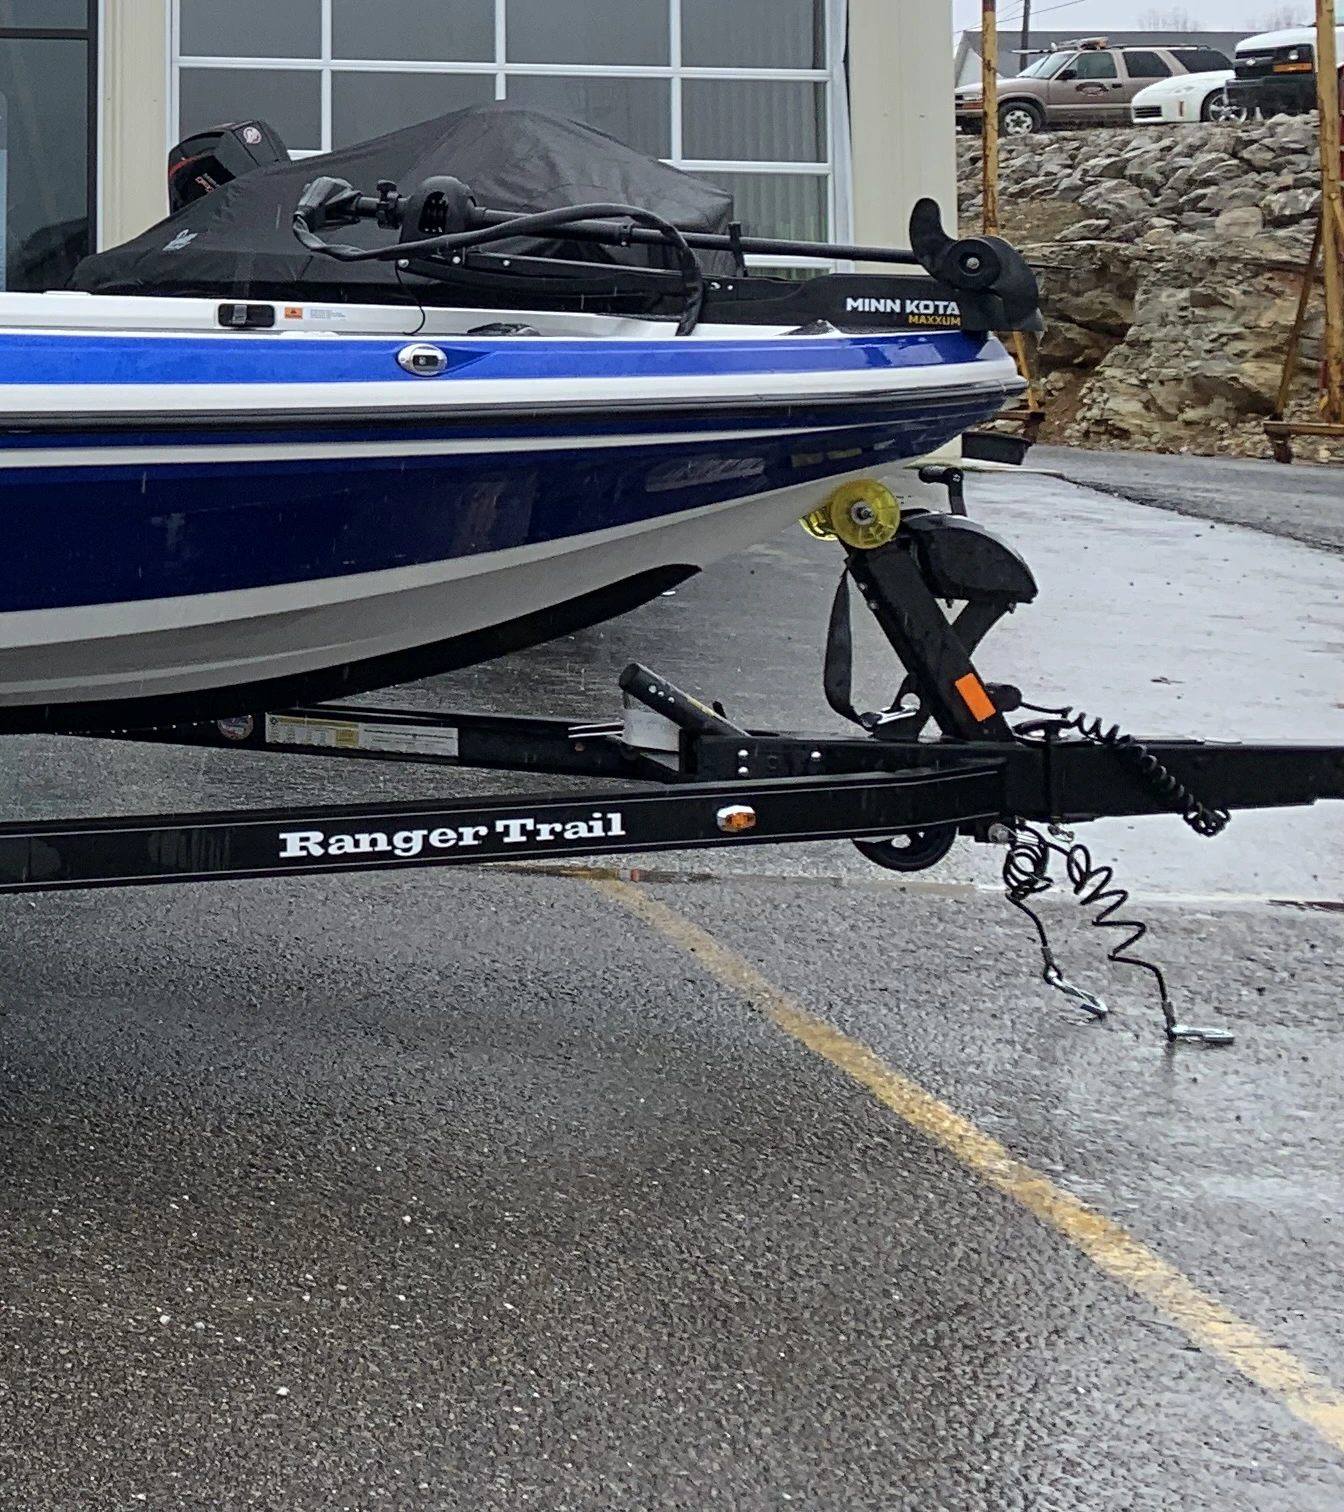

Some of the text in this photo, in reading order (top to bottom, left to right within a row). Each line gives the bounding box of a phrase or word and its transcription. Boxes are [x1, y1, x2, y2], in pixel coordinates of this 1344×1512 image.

[845, 297, 961, 315] MINN KOTA
[908, 314, 961, 326] MAXXUM
[278, 812, 627, 857] Ranger Trail
